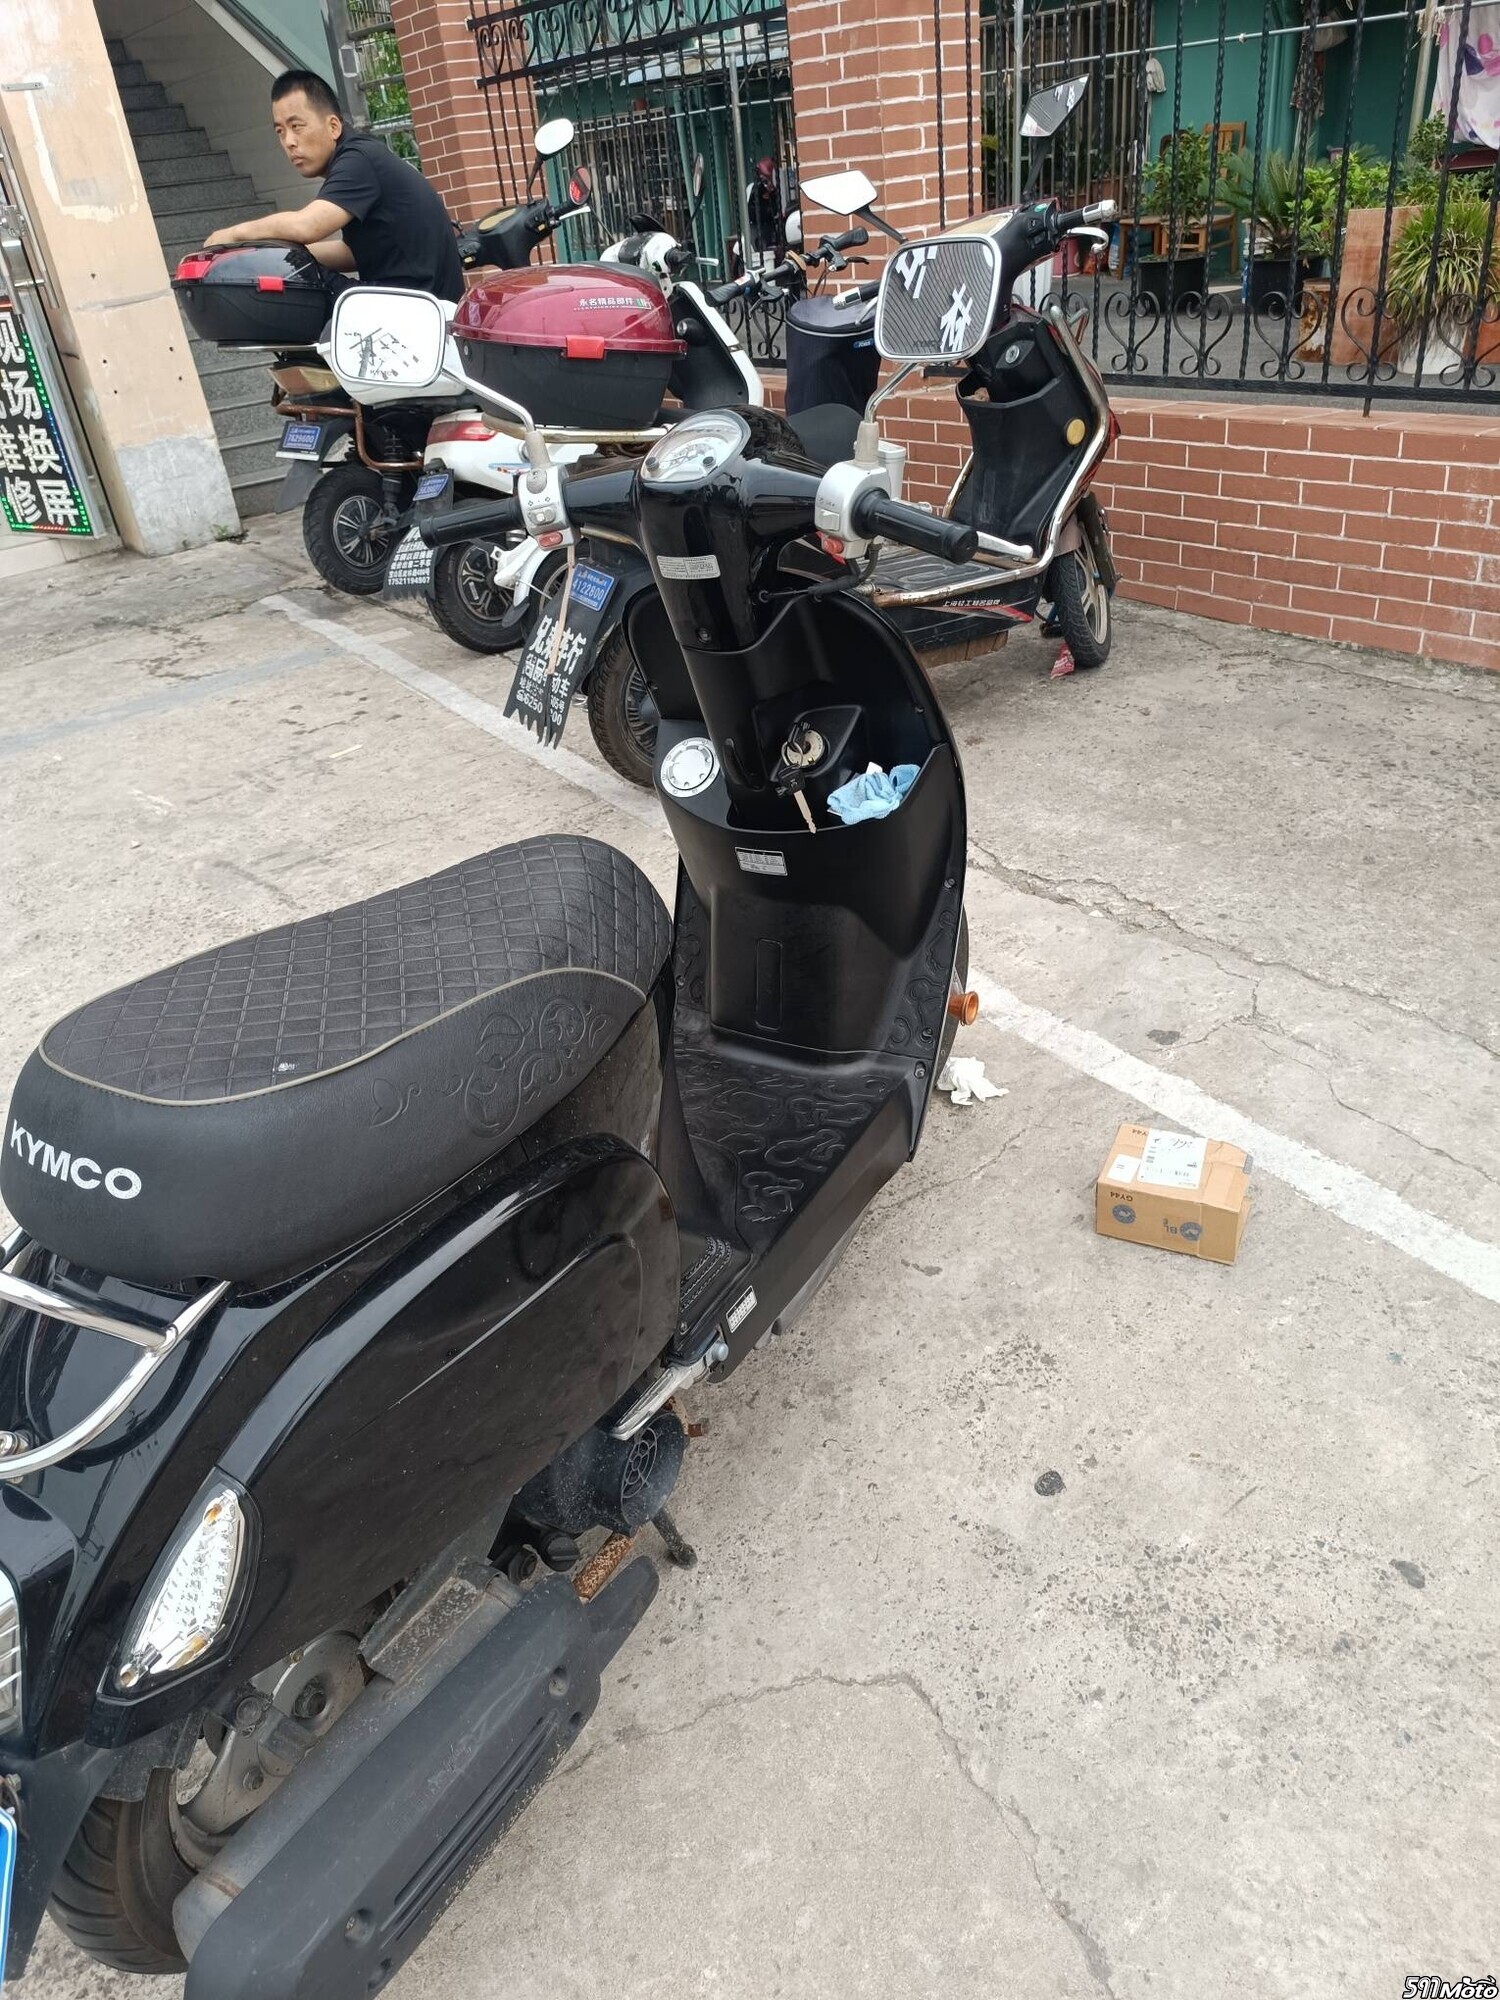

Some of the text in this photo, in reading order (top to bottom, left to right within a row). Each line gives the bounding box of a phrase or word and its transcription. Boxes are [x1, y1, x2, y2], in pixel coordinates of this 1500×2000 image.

[522, 653, 570, 698] 尚品动车
[10, 1118, 142, 1200] KYMCO
